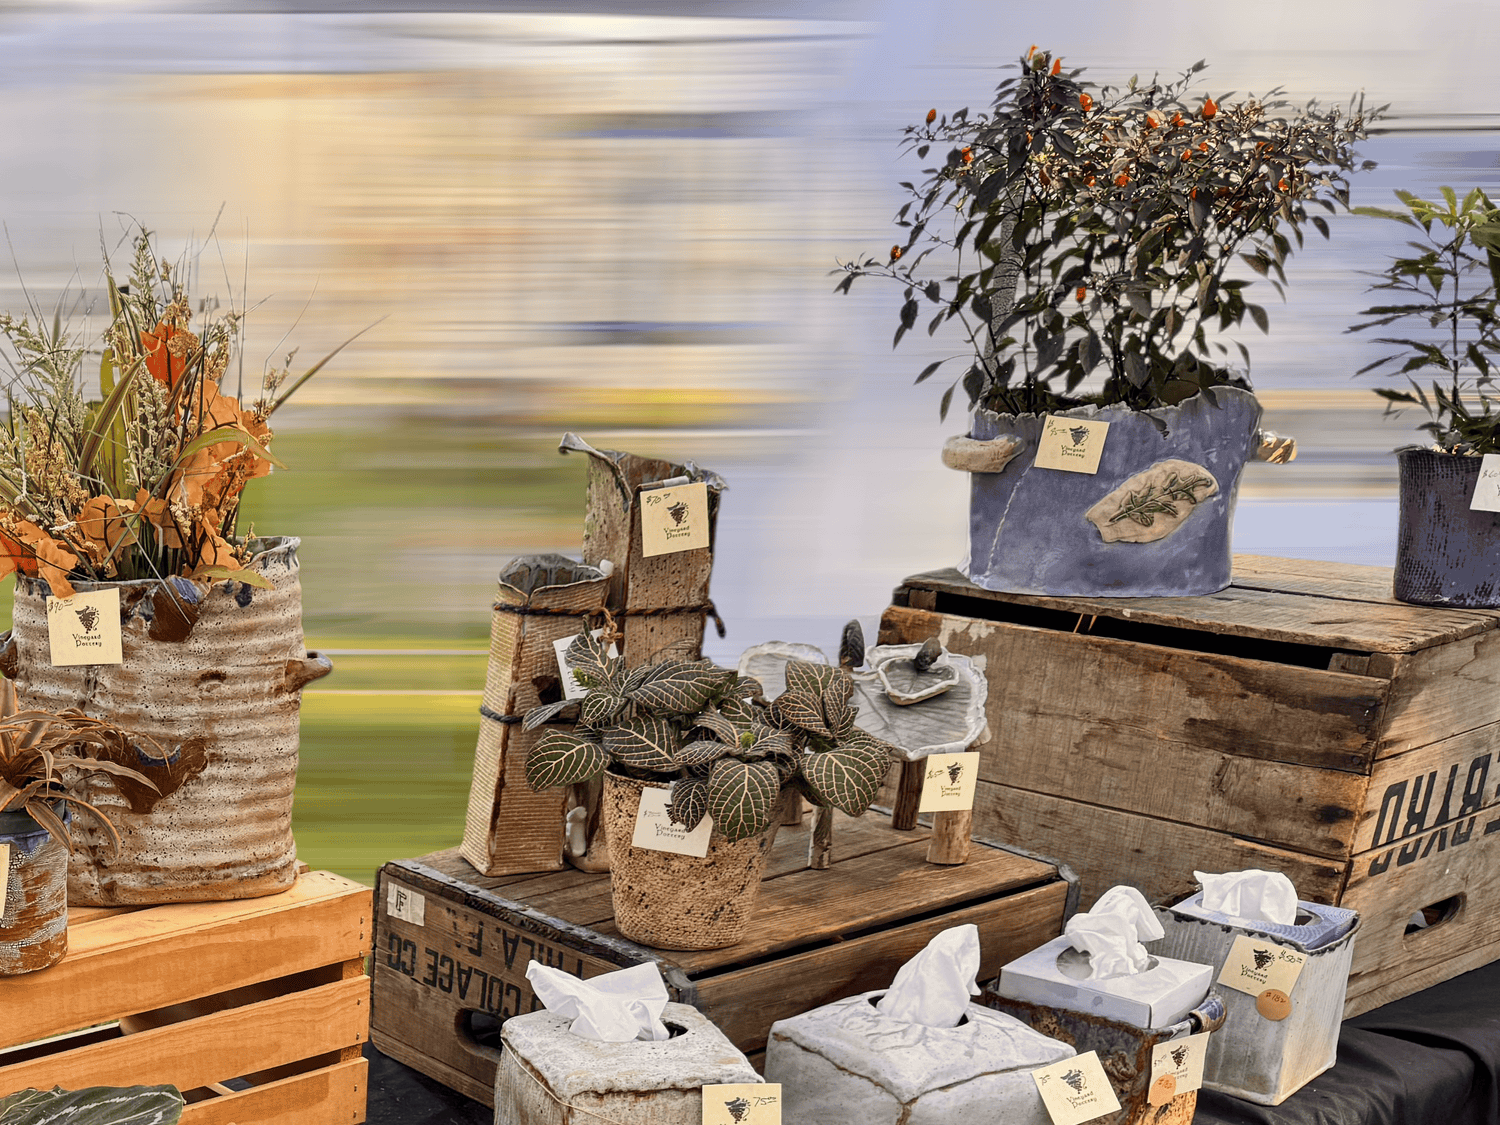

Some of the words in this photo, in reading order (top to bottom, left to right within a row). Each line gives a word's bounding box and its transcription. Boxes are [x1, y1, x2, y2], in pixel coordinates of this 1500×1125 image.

[663, 525, 690, 534] Vineyard
[666, 532, 691, 540] Pottery
[72, 633, 101, 642] Vineyard
[75, 640, 102, 648] Pottery
[655, 823, 686, 834] Vineyard
[656, 829, 685, 840] Pottery
[1240, 970, 1266, 984] Pottery
[1242, 964, 1268, 979] Vineyard
[1066, 1090, 1094, 1103] Vineyard
[1072, 1097, 1097, 1109] Pottery
